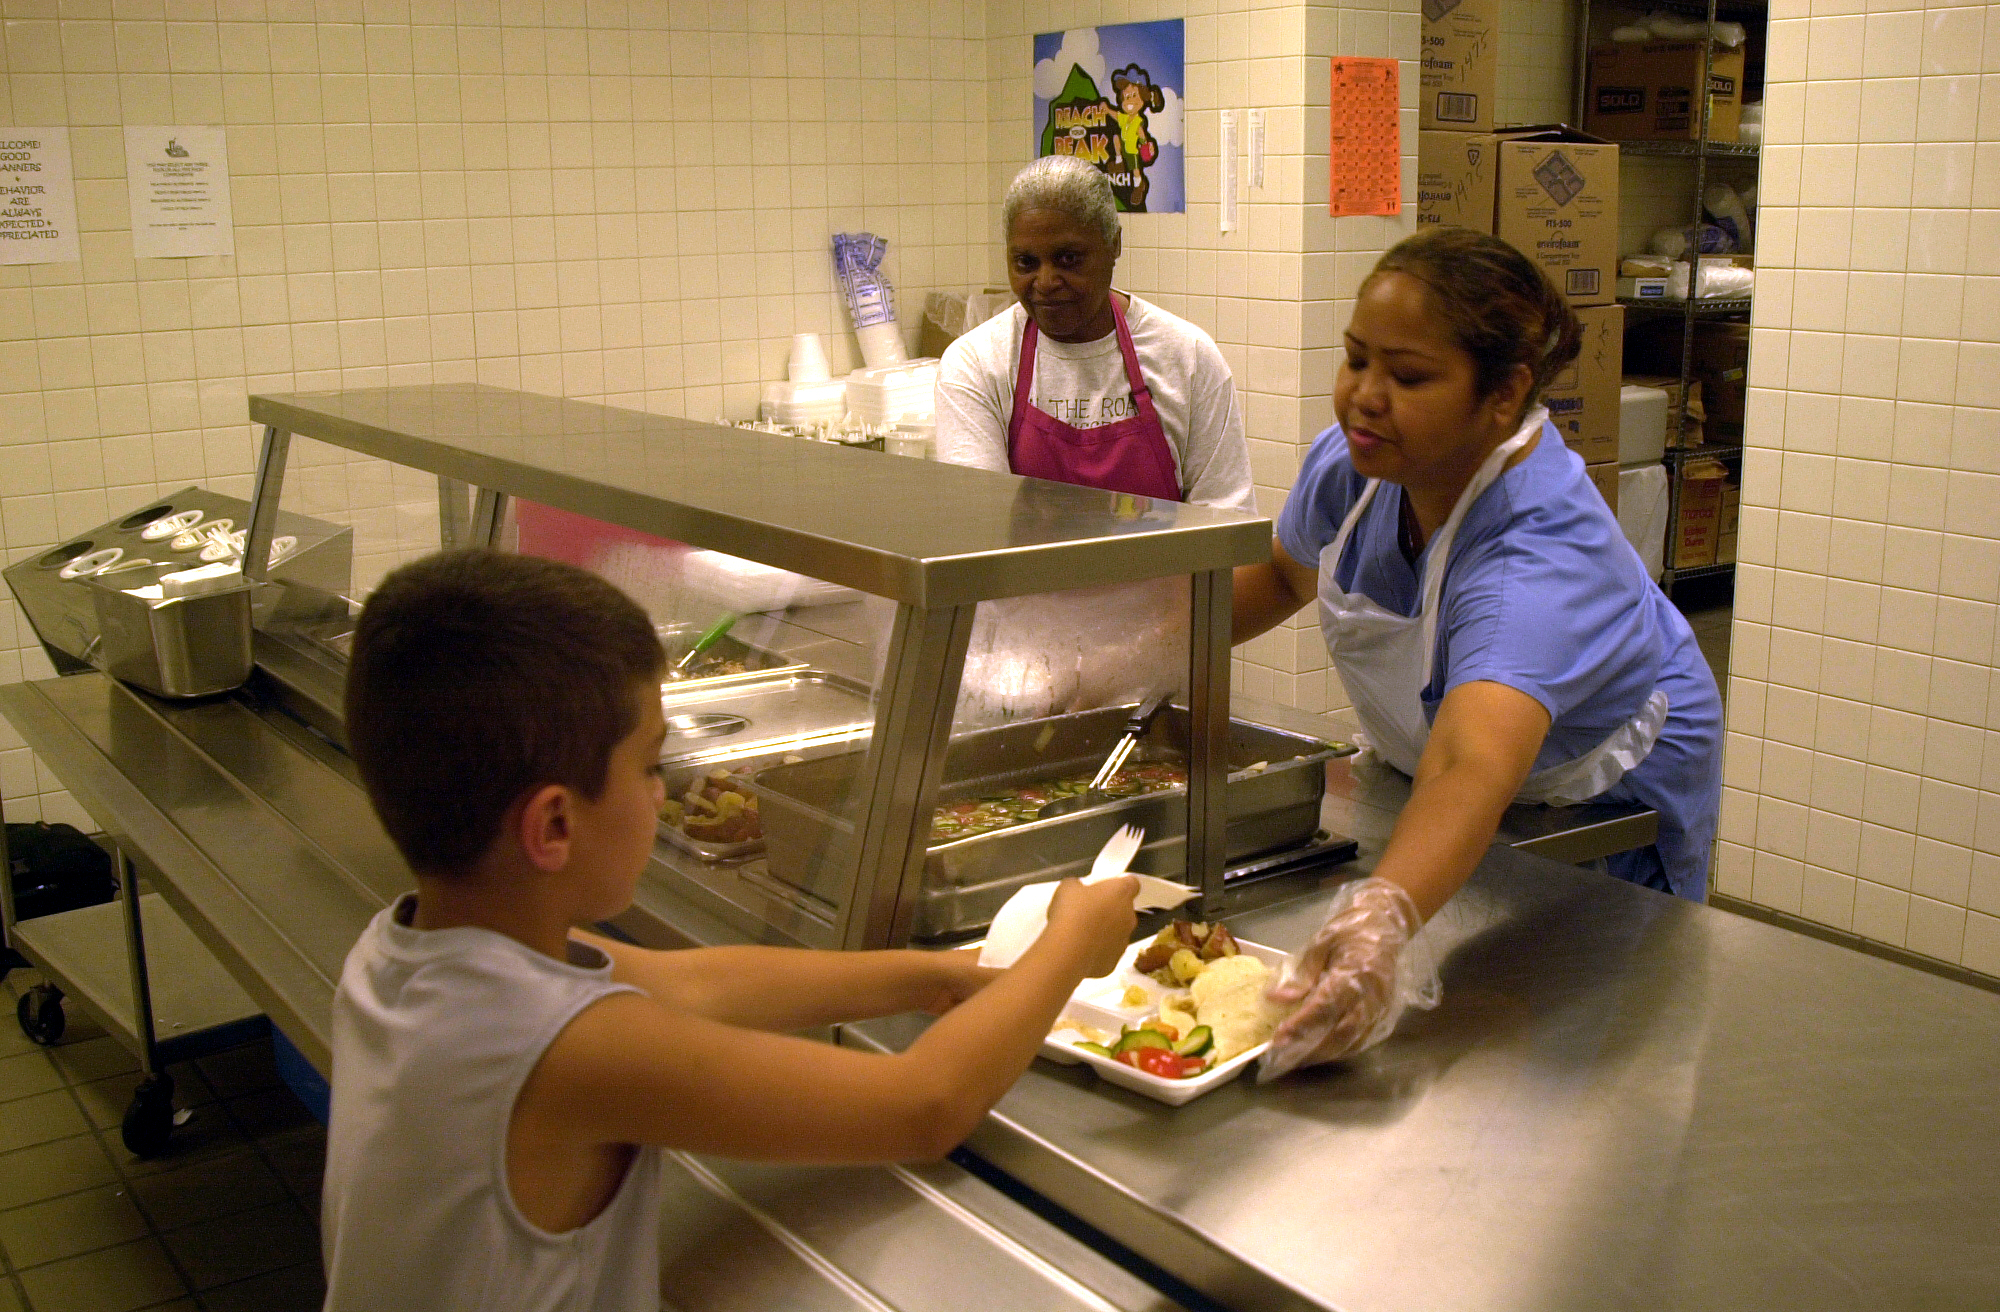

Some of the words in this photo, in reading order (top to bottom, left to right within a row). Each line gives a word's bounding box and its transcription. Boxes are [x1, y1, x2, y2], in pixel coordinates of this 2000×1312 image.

[1600, 93, 1641, 107] SOLO
[1054, 134, 1109, 163] PEAK
[1, 152, 31, 161] GOOD
[10, 197, 31, 206] ARE
[1, 208, 42, 218] ALWAYS
[1048, 398, 1090, 418] THE
